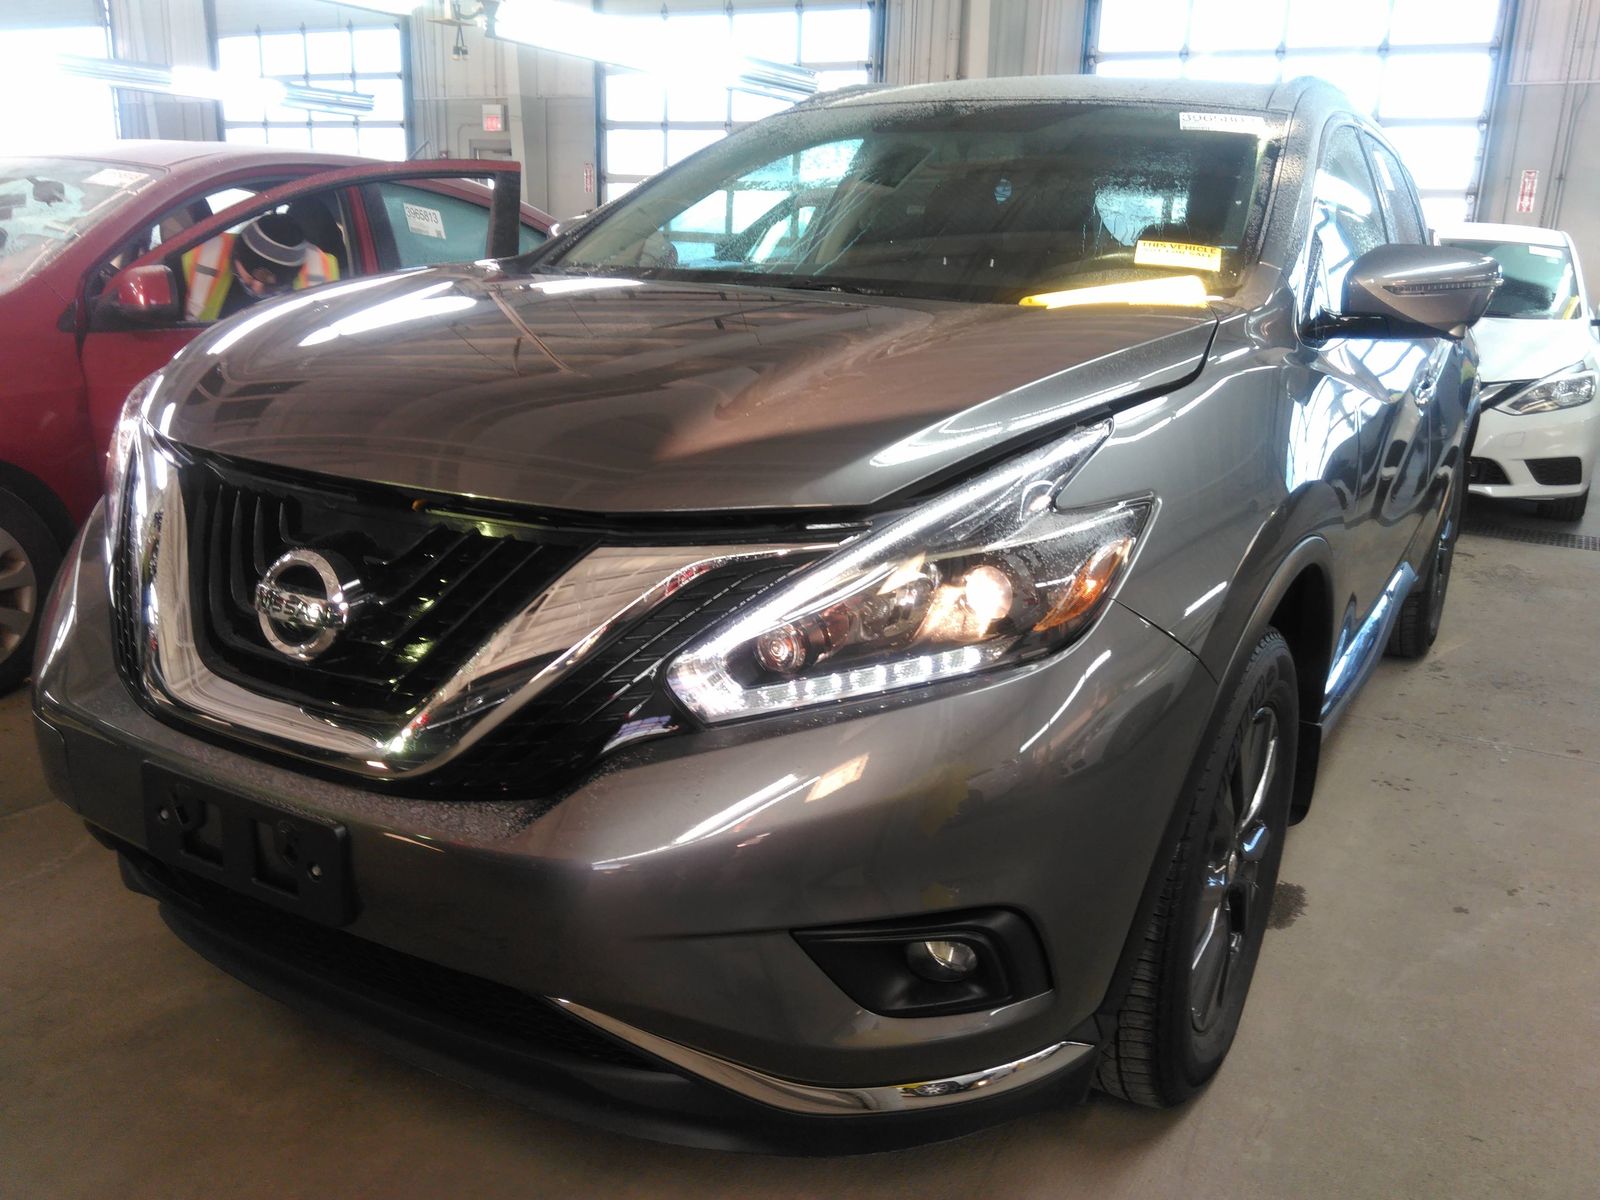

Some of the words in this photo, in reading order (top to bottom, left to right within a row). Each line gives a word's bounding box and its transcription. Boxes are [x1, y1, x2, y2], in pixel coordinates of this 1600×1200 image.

[405, 206, 439, 224] 3965813
[1142, 241, 1167, 249] THIS
[1169, 243, 1217, 255] VEHICLE
